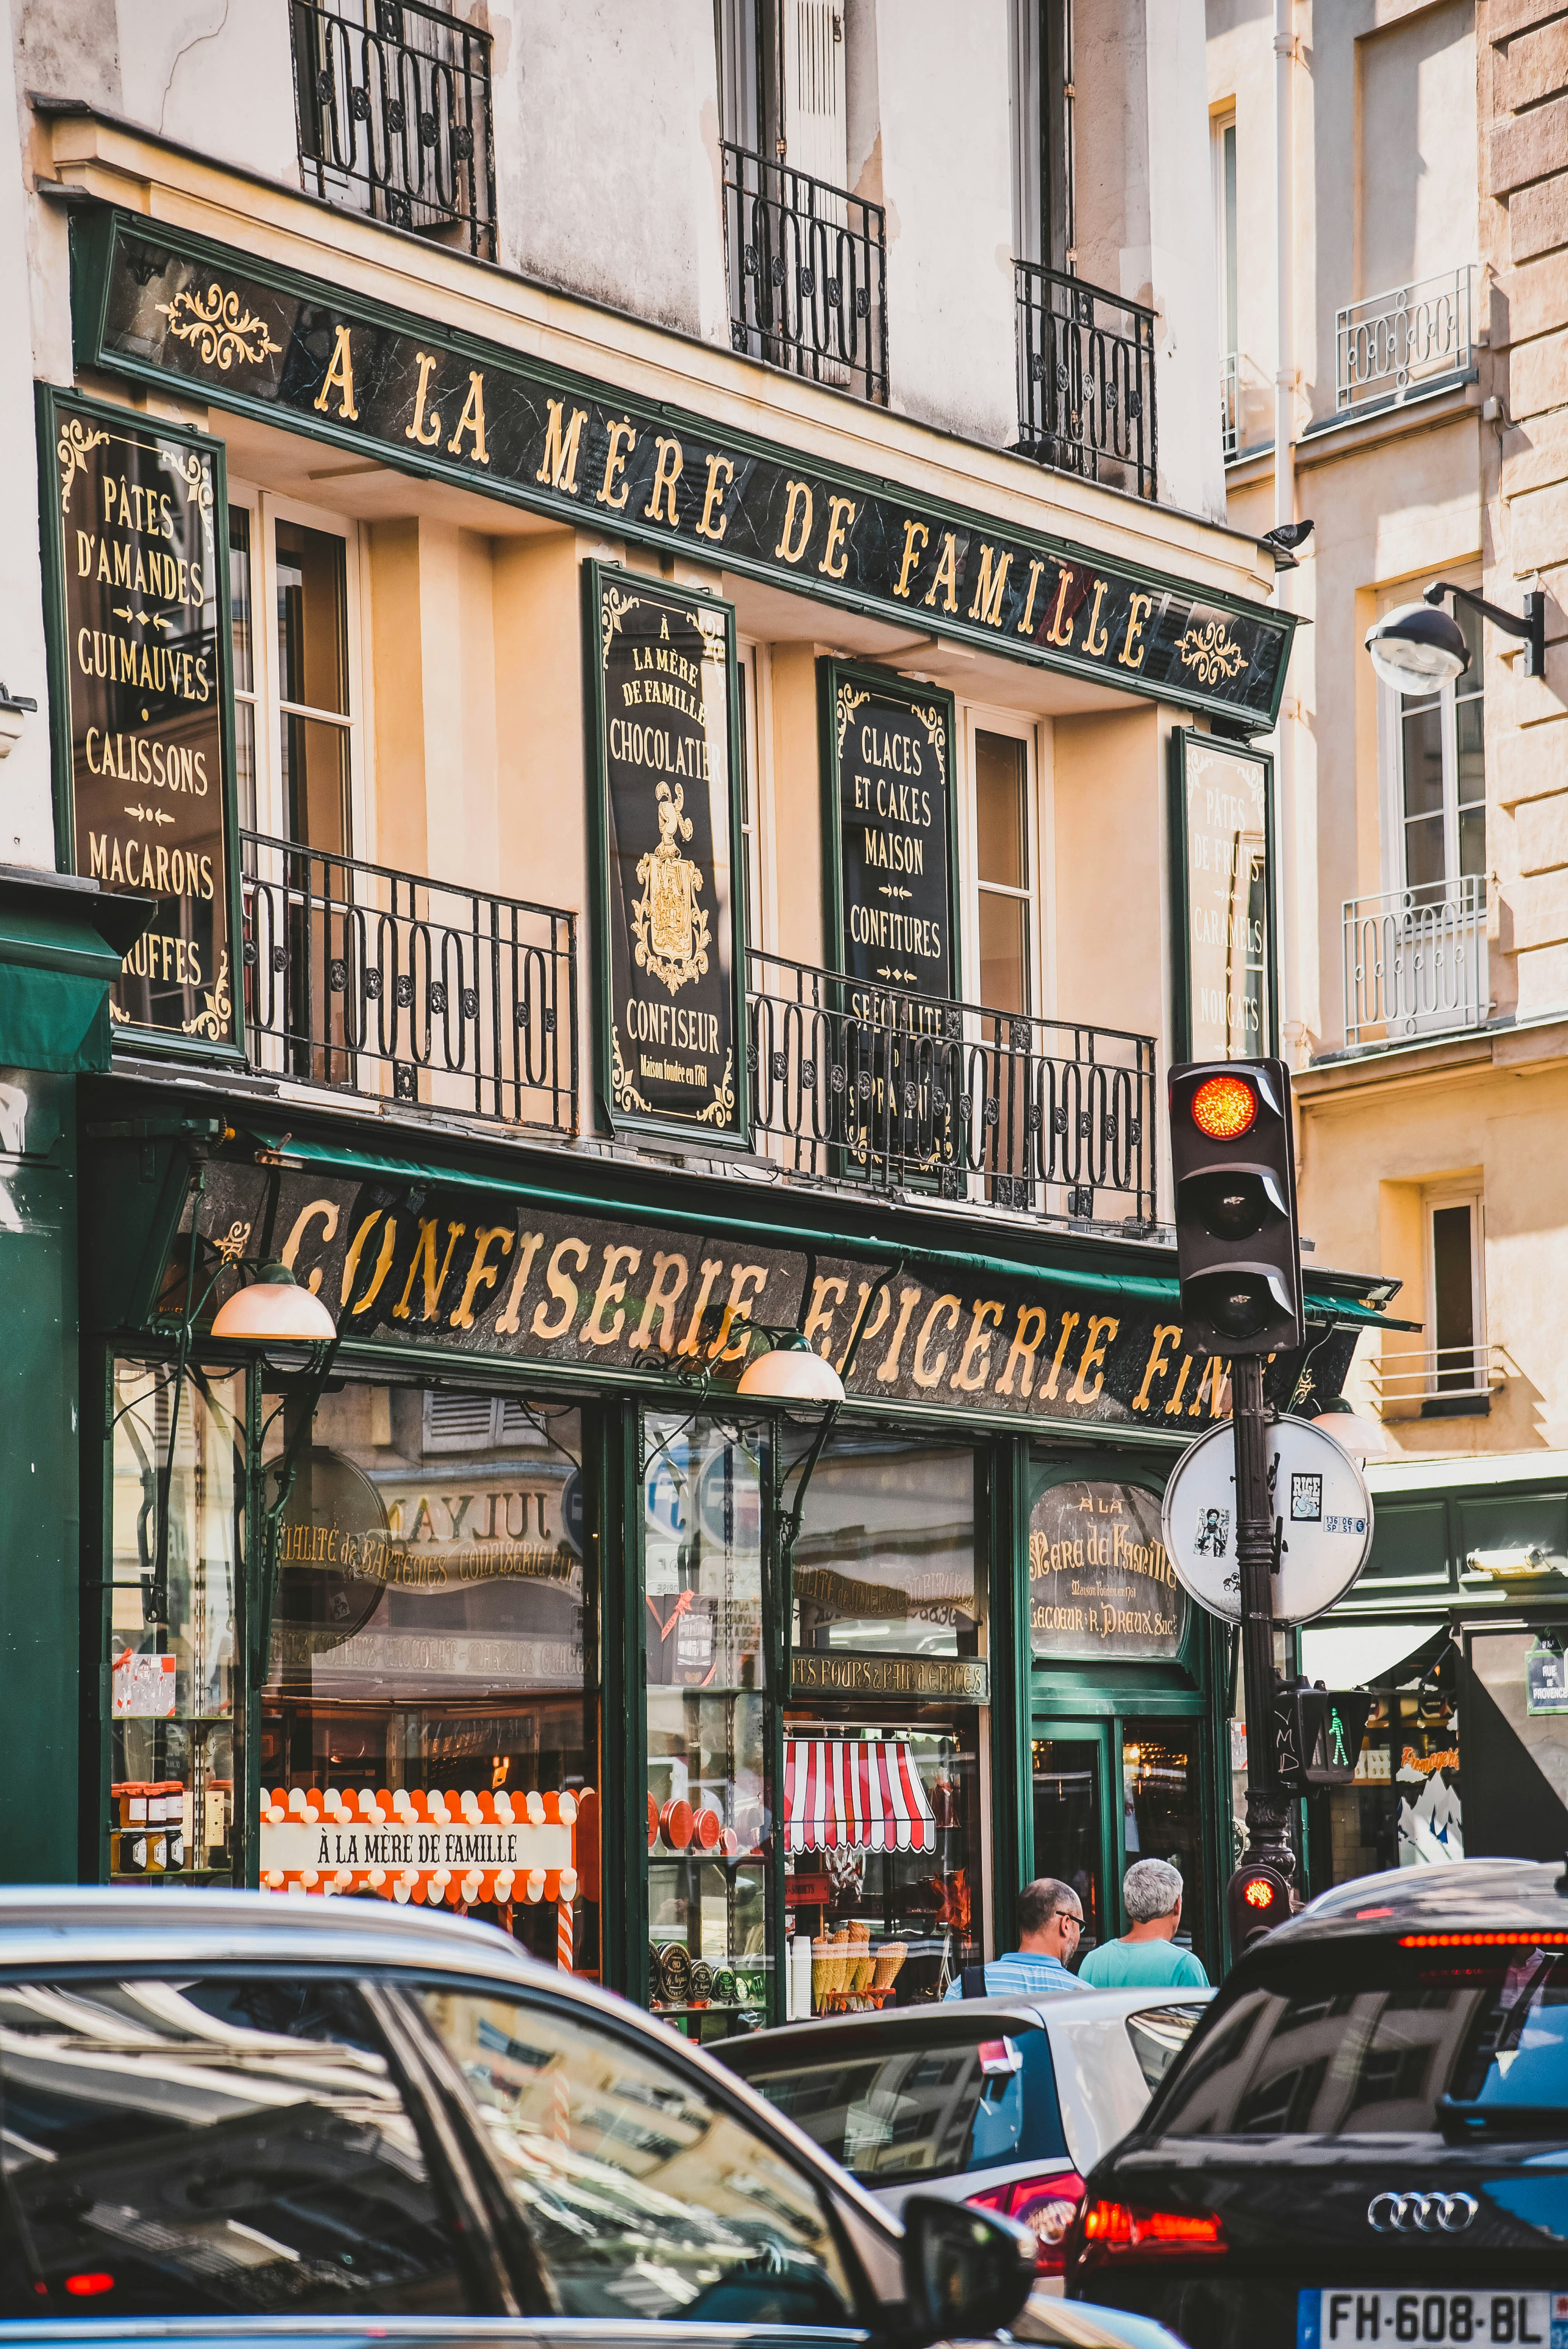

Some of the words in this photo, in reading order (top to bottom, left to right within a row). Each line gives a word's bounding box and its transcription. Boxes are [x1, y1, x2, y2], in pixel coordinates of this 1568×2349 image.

[103, 475, 174, 539] PÂTES
[314, 325, 358, 421] A
[405, 352, 489, 464] LA
[775, 480, 856, 579] DE
[893, 520, 1153, 668] FAMILLE
[76, 529, 204, 608] D'AMANDES
[660, 614, 670, 640] À
[78, 627, 209, 702] GUIMAUVES
[633, 647, 654, 671] LA
[656, 648, 698, 689] MÈRE
[622, 681, 643, 707] DE
[643, 680, 708, 728] FAMILLE
[86, 726, 208, 797] CALISSONS
[610, 718, 722, 784] CHOCOLATIER
[862, 725, 922, 776] GLACES
[855, 775, 870, 810] ET
[877, 779, 931, 827] CAKES
[1206, 787, 1246, 832] PÂTES
[89, 831, 214, 900] MACARONS
[864, 827, 924, 875] MAISON
[1194, 833, 1210, 870] DE
[1215, 838, 1259, 882] FRUITS
[850, 904, 941, 958] CONFITURES
[1194, 906, 1262, 954] CARAMELS
[626, 998, 720, 1055] CONFISEUR
[1200, 987, 1259, 1032] NOUGATS
[640, 1054, 663, 1078] Maison
[664, 1059, 685, 1083] fondée
[686, 1067, 694, 1084] en
[695, 1065, 707, 1087] 1761
[281, 1199, 768, 1361] CONFISERIE
[804, 1275, 1120, 1405] EPICERIE
[1132, 1324, 1276, 1419] FIN
[1098, 1498, 1123, 1514] LA
[820, 1658, 871, 1688] FOURS
[1542, 1665, 1557, 1677] RUE
[317, 1827, 330, 1864] À
[336, 1834, 359, 1864] LA
[364, 1826, 413, 1863] MÈRE
[418, 1834, 440, 1864] DE
[445, 1834, 518, 1863] FAMILLE
